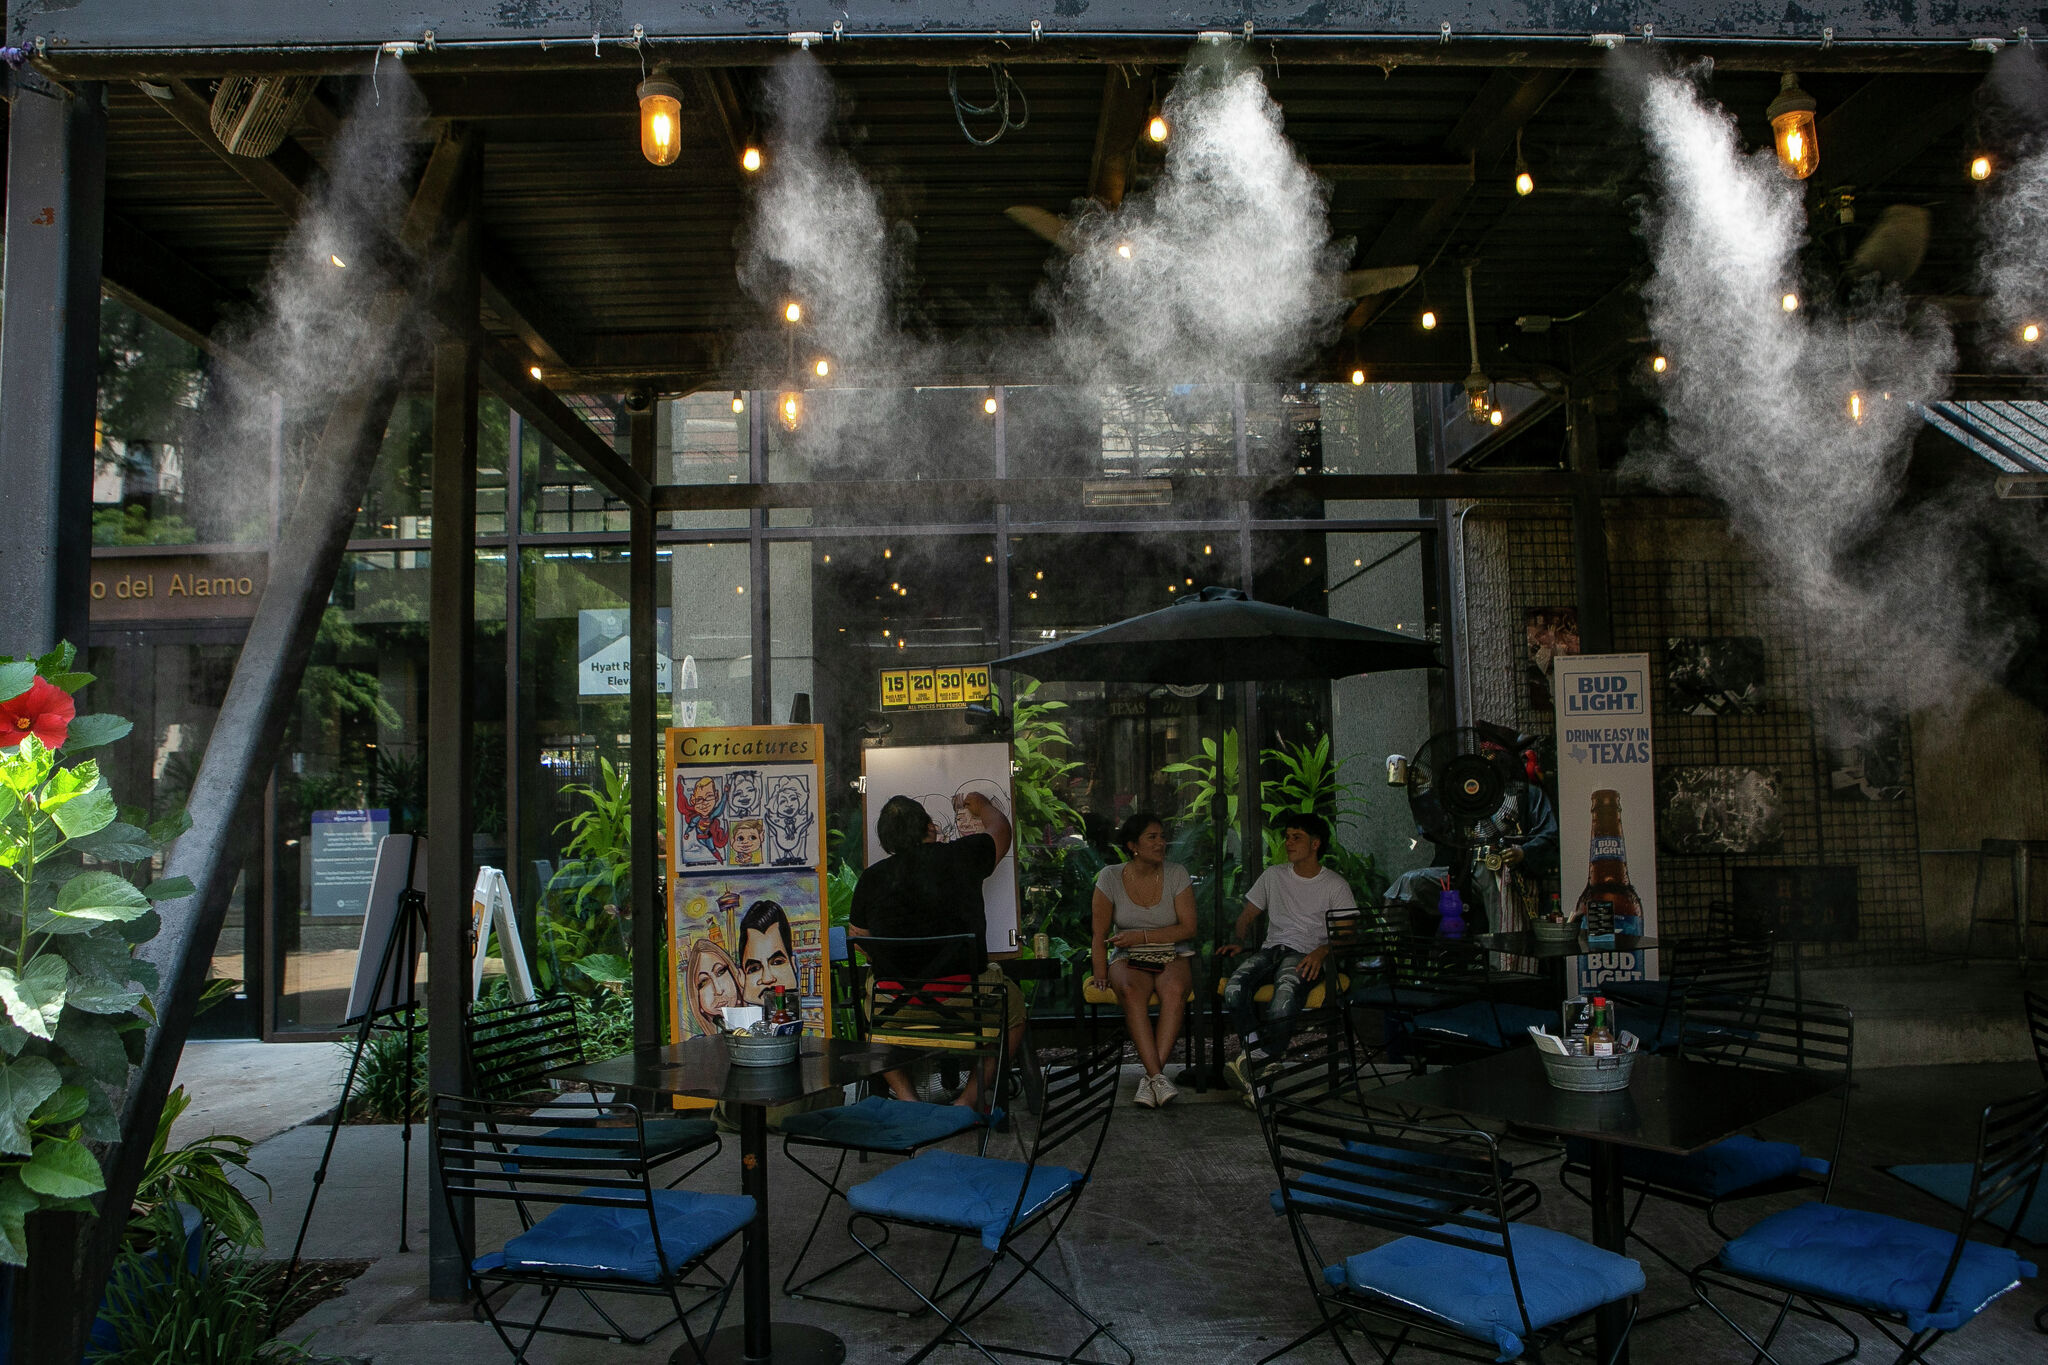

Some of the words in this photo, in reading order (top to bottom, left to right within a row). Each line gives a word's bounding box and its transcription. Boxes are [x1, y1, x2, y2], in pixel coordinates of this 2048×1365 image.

[116, 575, 154, 599] del
[168, 573, 253, 597] Alamo
[591, 662, 620, 674] Hyatt
[1578, 676, 1628, 694] BUD
[1110, 702, 1146, 715] TEXAS
[1569, 693, 1638, 711] LIGHT
[1566, 728, 1602, 743] DRINK
[1604, 728, 1635, 742] EASY
[1636, 727, 1649, 741] IN
[680, 737, 808, 757] Caricatures
[1588, 742, 1650, 764] TEXAS
[1595, 847, 1622, 855] LIGHT
[1598, 839, 1618, 848] BUD
[1587, 952, 1636, 970] BUD
